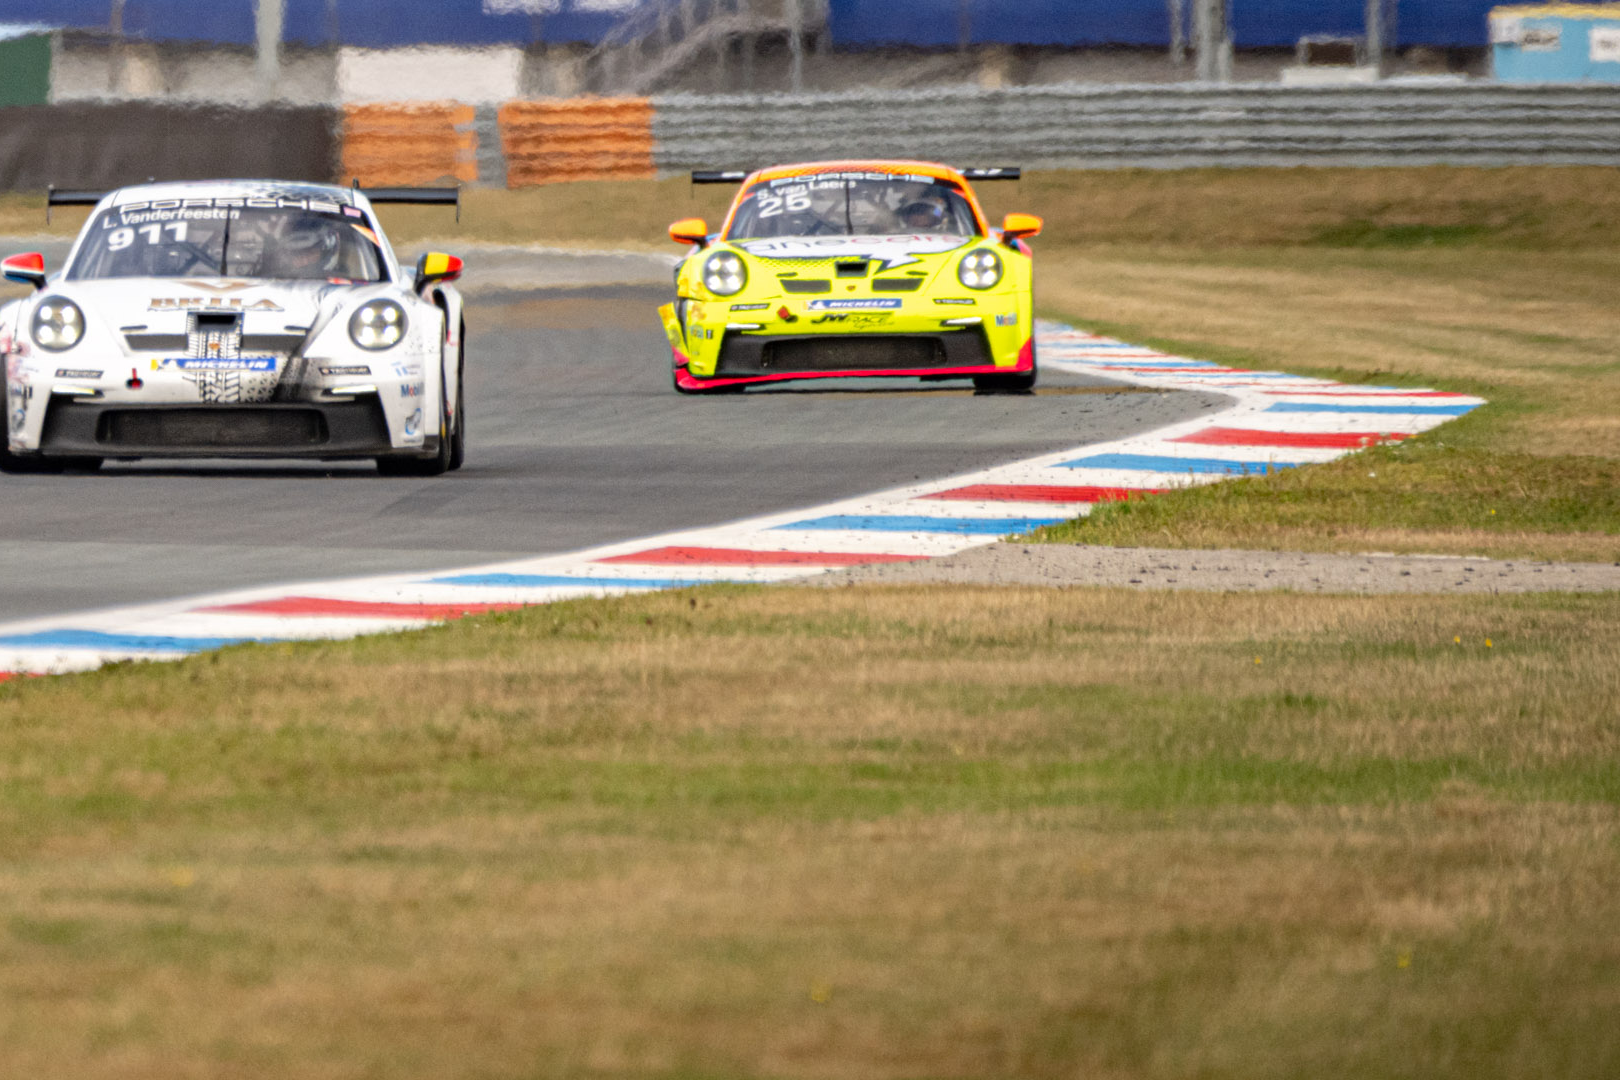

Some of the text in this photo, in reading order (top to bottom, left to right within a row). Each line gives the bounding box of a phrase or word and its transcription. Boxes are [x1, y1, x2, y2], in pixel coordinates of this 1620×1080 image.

[770, 172, 934, 188] PORSCHE
[757, 188, 773, 200] S.
[775, 183, 808, 196] van
[120, 198, 340, 214] PORSCHE
[758, 191, 811, 218] 25
[103, 208, 240, 229] L. Vanderfeesten
[107, 221, 189, 251] 911
[829, 300, 896, 308] MICHELIN
[184, 360, 269, 369] MICHELIN
